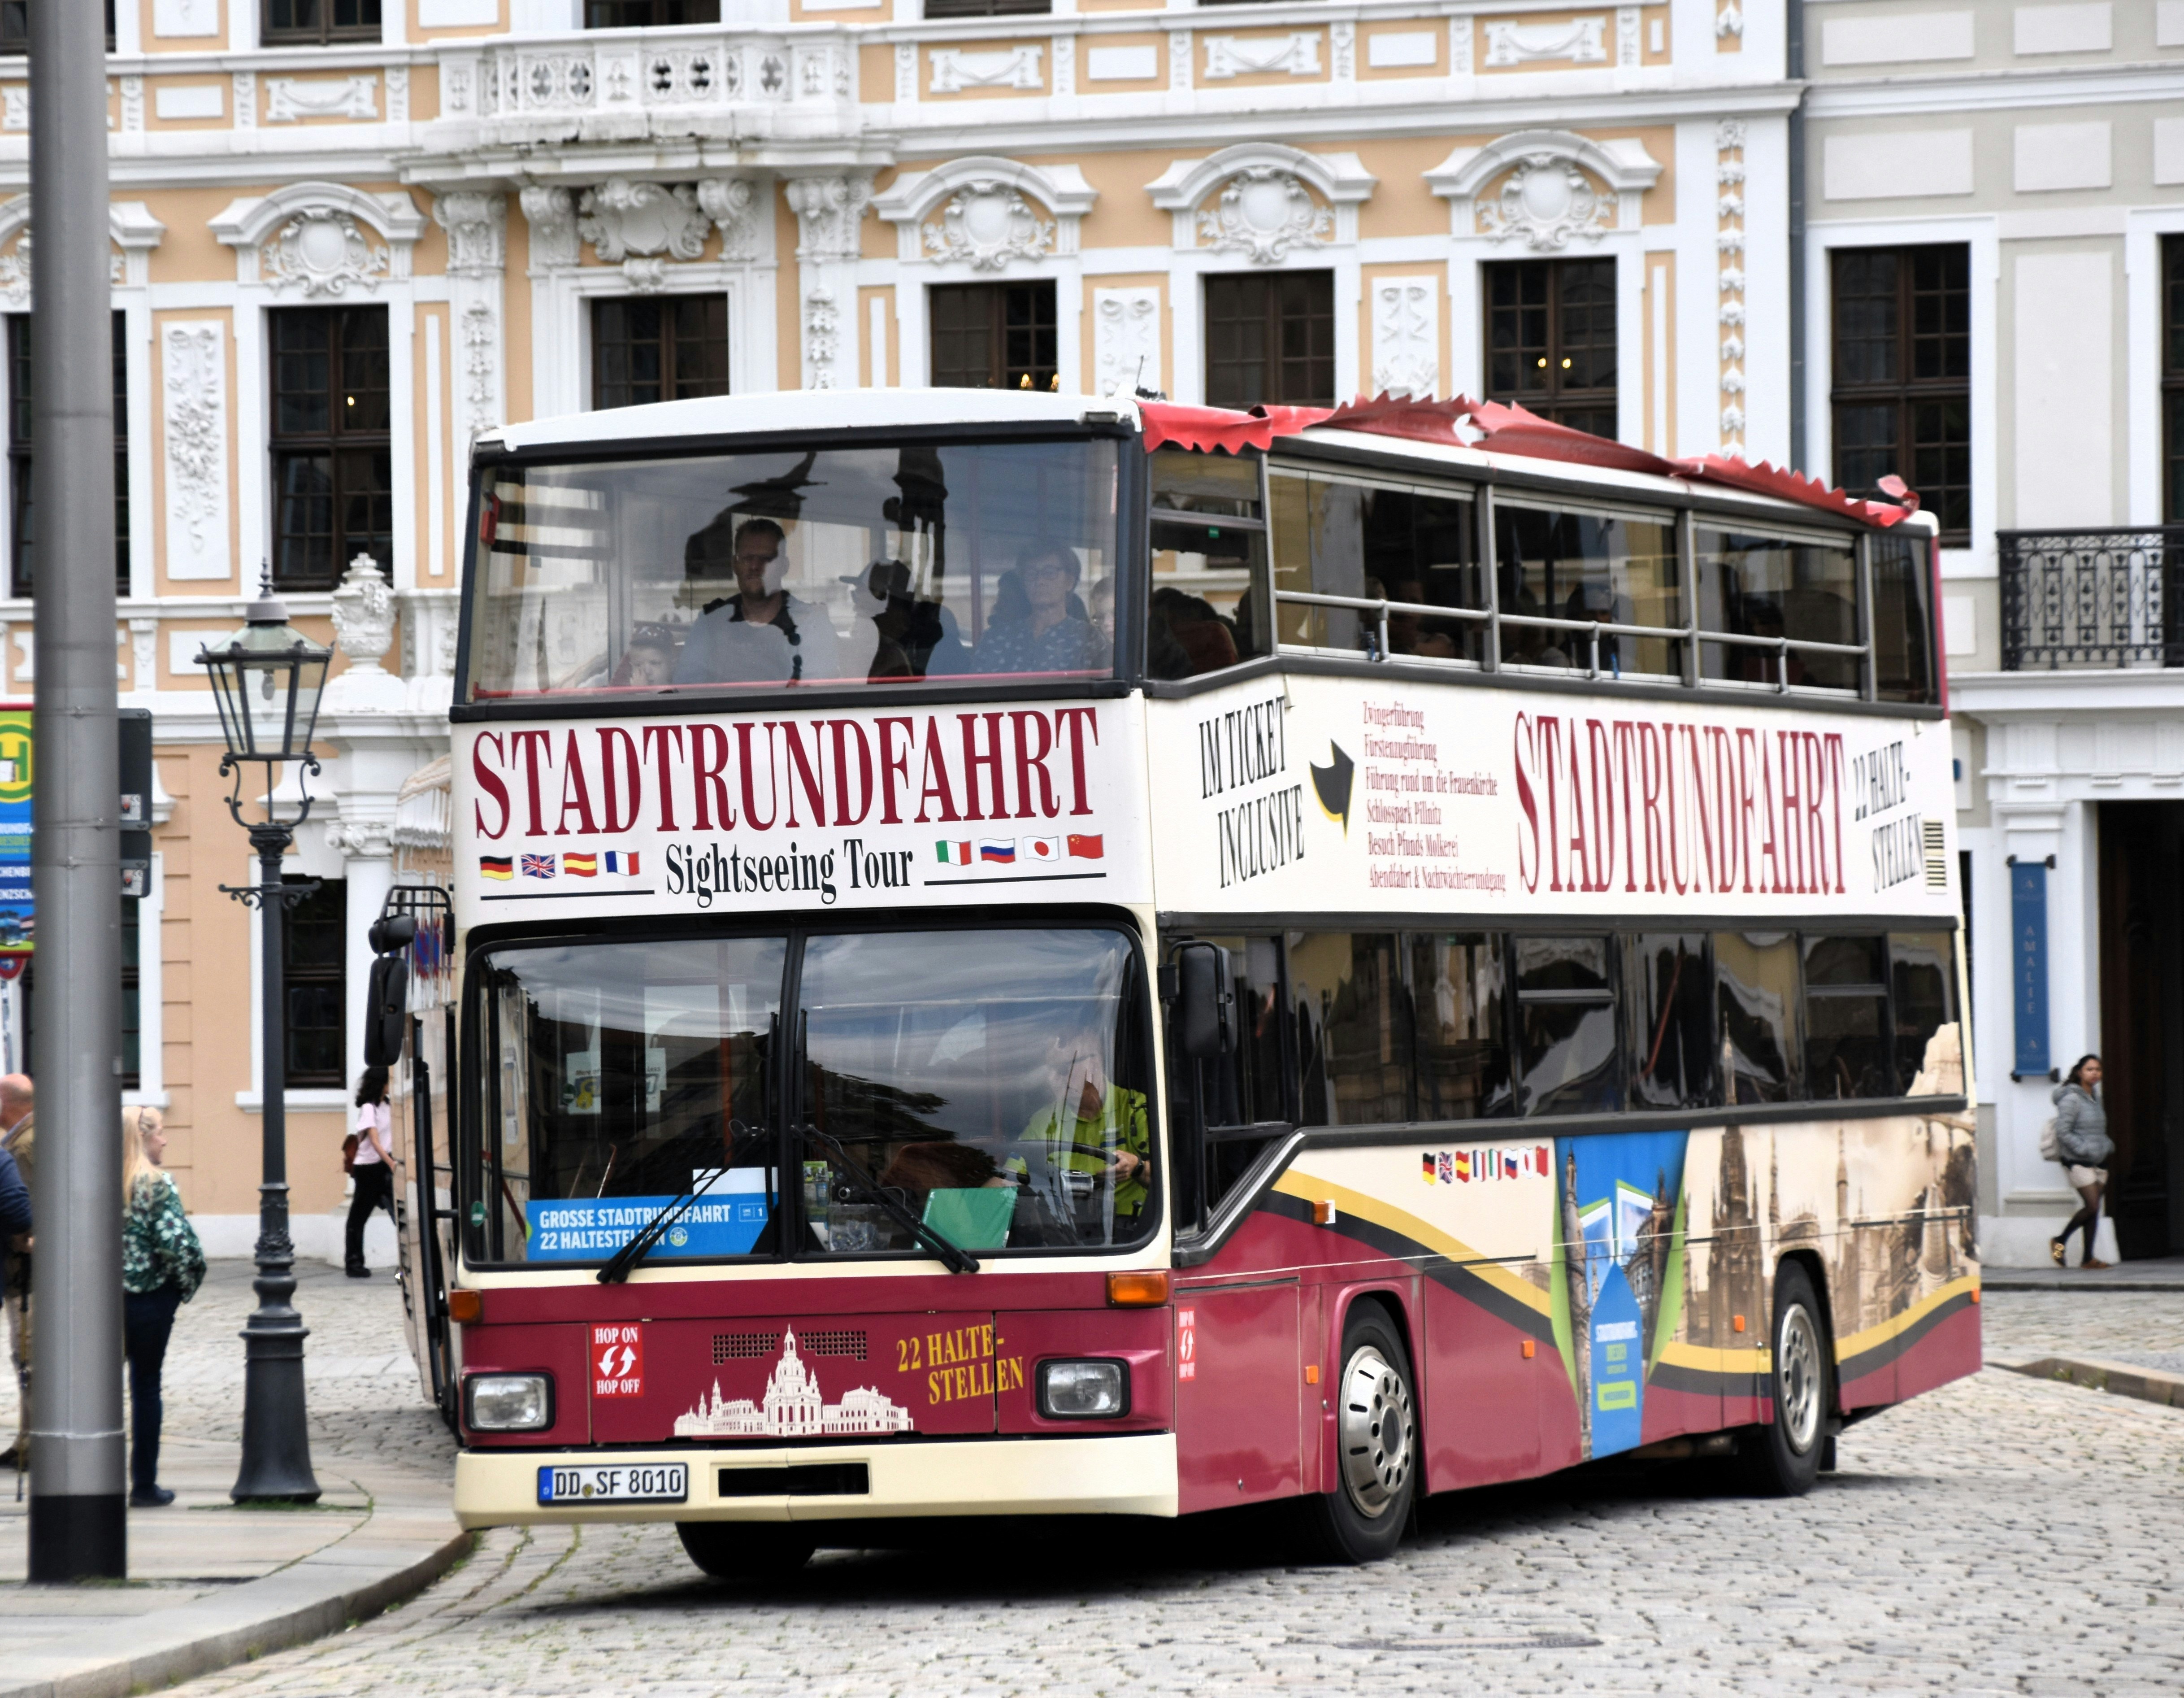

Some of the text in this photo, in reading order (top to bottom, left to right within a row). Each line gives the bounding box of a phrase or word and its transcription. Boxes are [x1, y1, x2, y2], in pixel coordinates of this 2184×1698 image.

[1363, 701, 1424, 735] Zwingerführung
[1199, 695, 1287, 800] IM TICKET
[1364, 734, 1437, 768] Fürstenzugführung
[473, 707, 1099, 840] STADTRUNDFAHRT
[1366, 766, 1498, 798] Führung rund um die Frauenkirche
[1853, 740, 1910, 822] 22 HALTE-
[1367, 798, 1442, 831] Schlosspark Pillnitz
[1515, 710, 1846, 896] STADTRUNDFAHRT
[1217, 784, 1305, 889] INCLUSIVE
[1368, 831, 1459, 857] Besuch Pfunds Molkerei
[1872, 812, 1923, 894] STELLEN
[666, 839, 913, 908] Sightseeing Tour
[1369, 863, 1412, 888] Abendfahrt
[1415, 866, 1420, 888] &
[540, 1210, 595, 1228] GROSSE
[540, 1232, 557, 1250] 22
[595, 1327, 638, 1345] HOP ON
[897, 1324, 1004, 1372] 22 HALTE-
[596, 1379, 640, 1394] HOP OFF
[928, 1356, 1024, 1405] STELLEN
[554, 1472, 581, 1496] DD
[596, 1471, 621, 1495] SF
[629, 1469, 682, 1494] 8010
